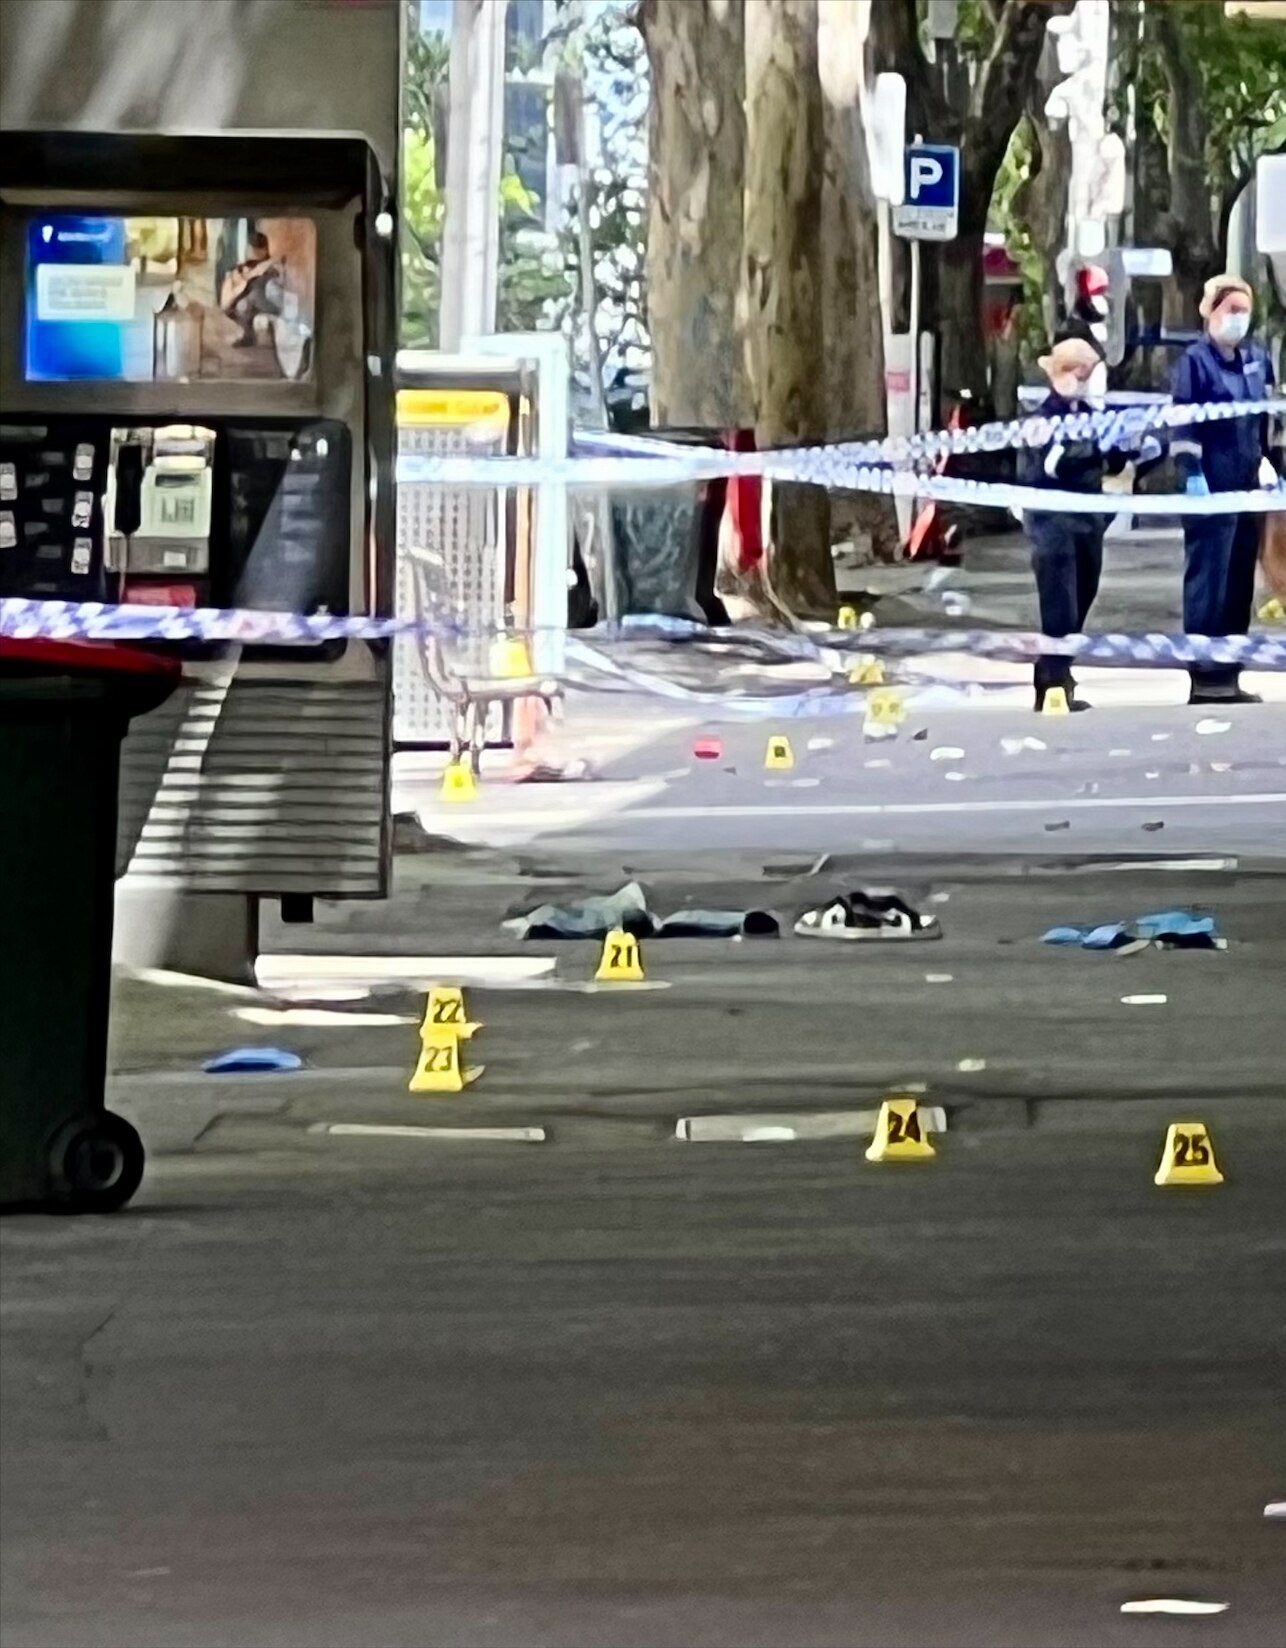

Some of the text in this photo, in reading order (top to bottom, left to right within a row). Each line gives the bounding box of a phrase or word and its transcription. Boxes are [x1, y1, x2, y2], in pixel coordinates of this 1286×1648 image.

[910, 157, 943, 199] P
[610, 944, 635, 968] 21
[433, 998, 462, 1024] 22
[424, 1046, 453, 1072] 23
[887, 1110, 921, 1143] 24
[1174, 1133, 1209, 1166] 25
